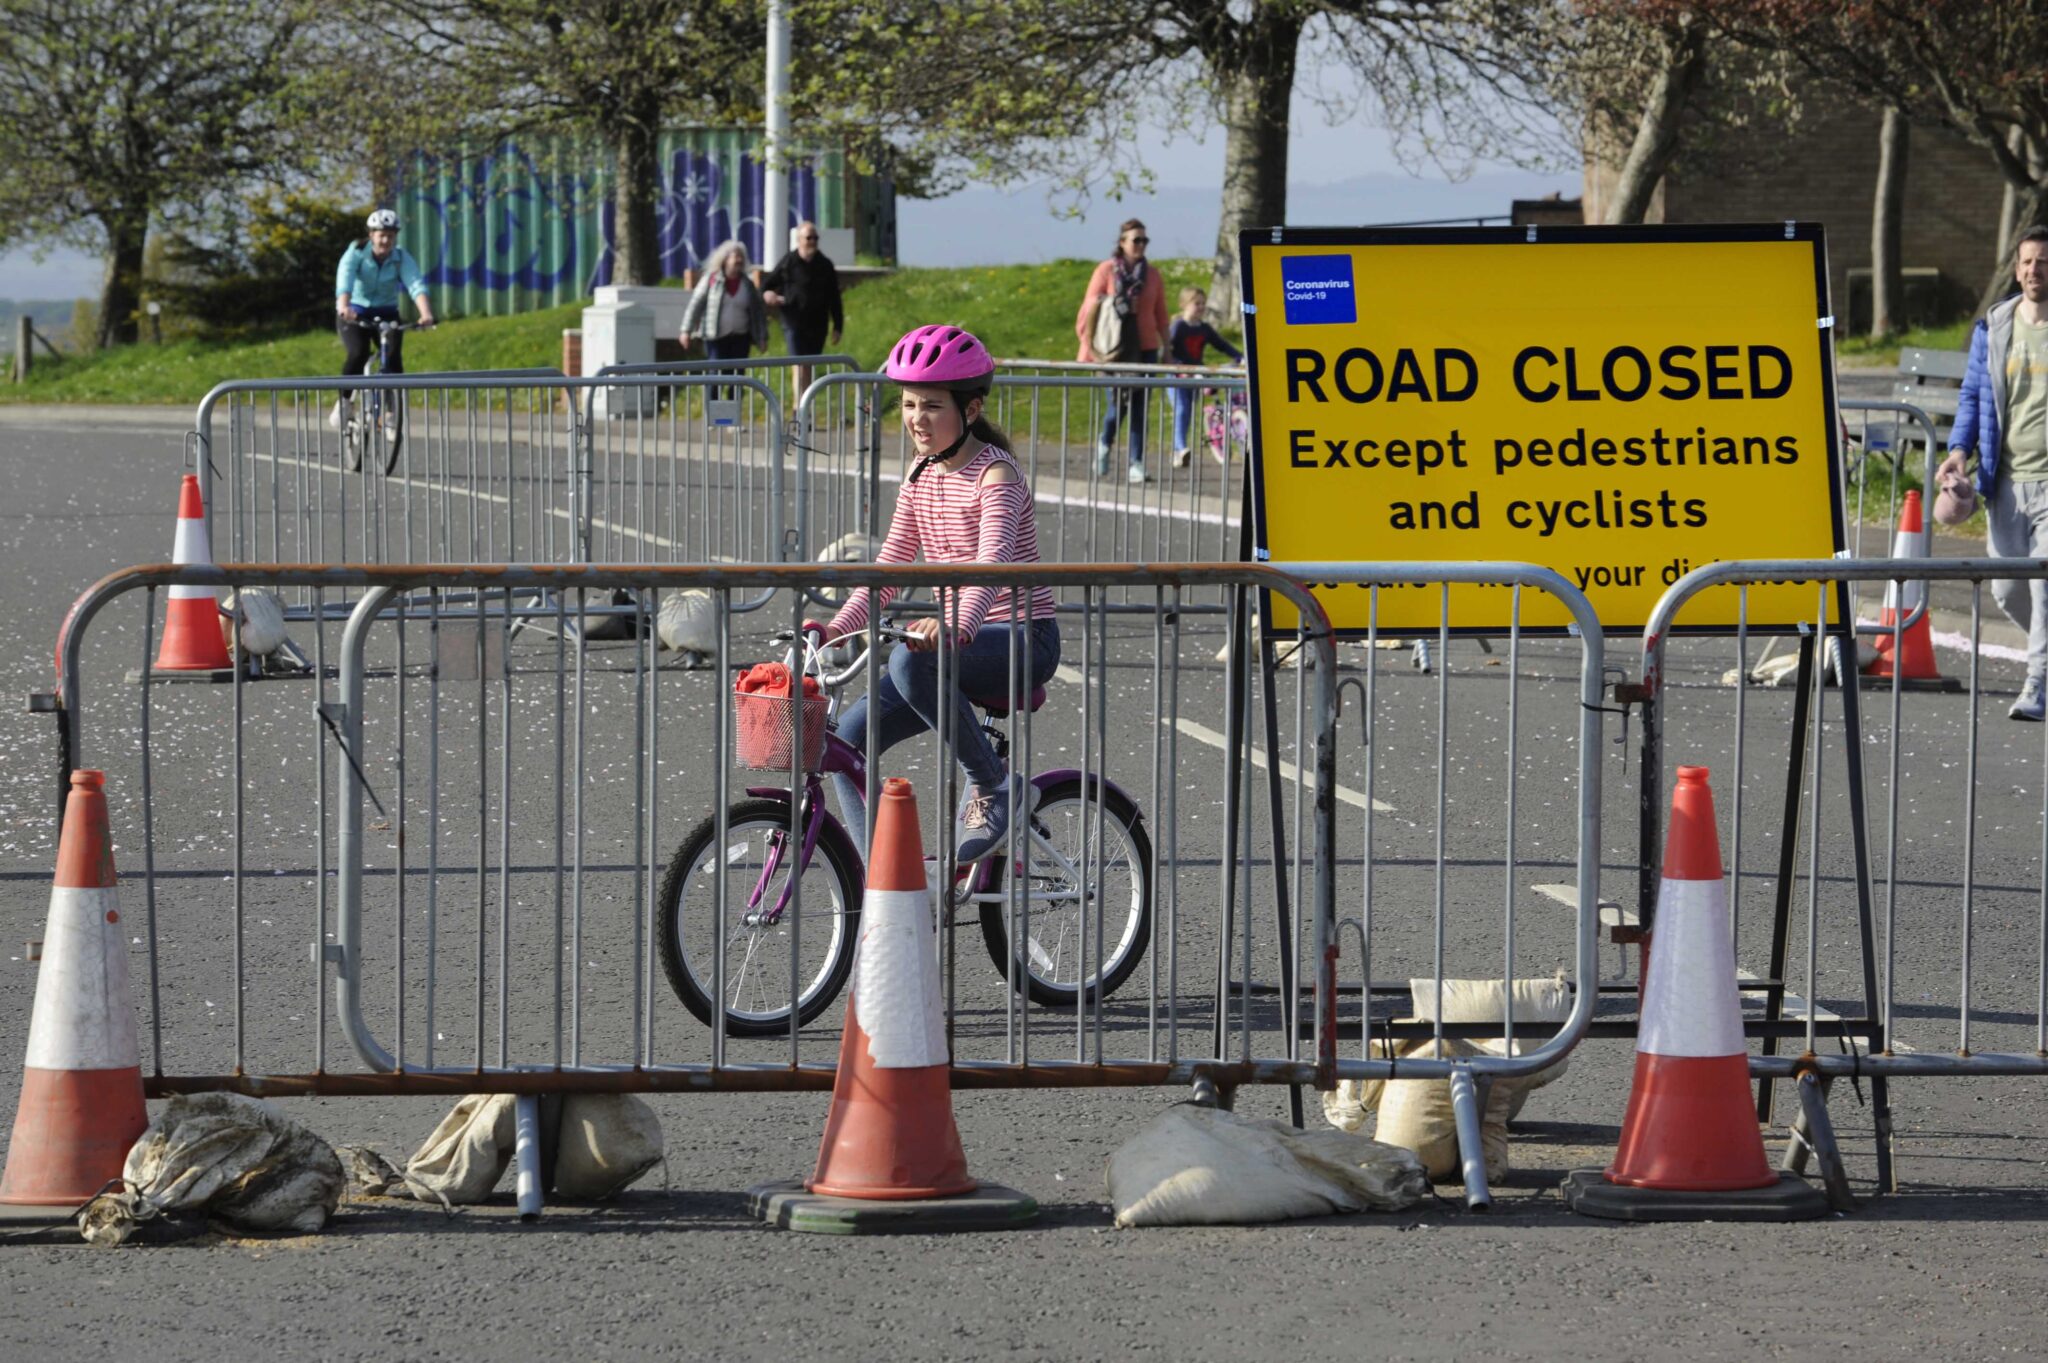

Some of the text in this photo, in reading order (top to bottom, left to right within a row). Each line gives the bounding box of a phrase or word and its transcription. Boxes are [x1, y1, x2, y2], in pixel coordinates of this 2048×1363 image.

[1286, 279, 1350, 290] Coronavirus
[1287, 291, 1327, 301] Covid-19
[1285, 344, 1793, 405] ROAD CLOSED
[1289, 426, 1799, 476] Except pedestrians
[1389, 489, 1708, 537] and cyclists
[1574, 565, 1646, 593] your
